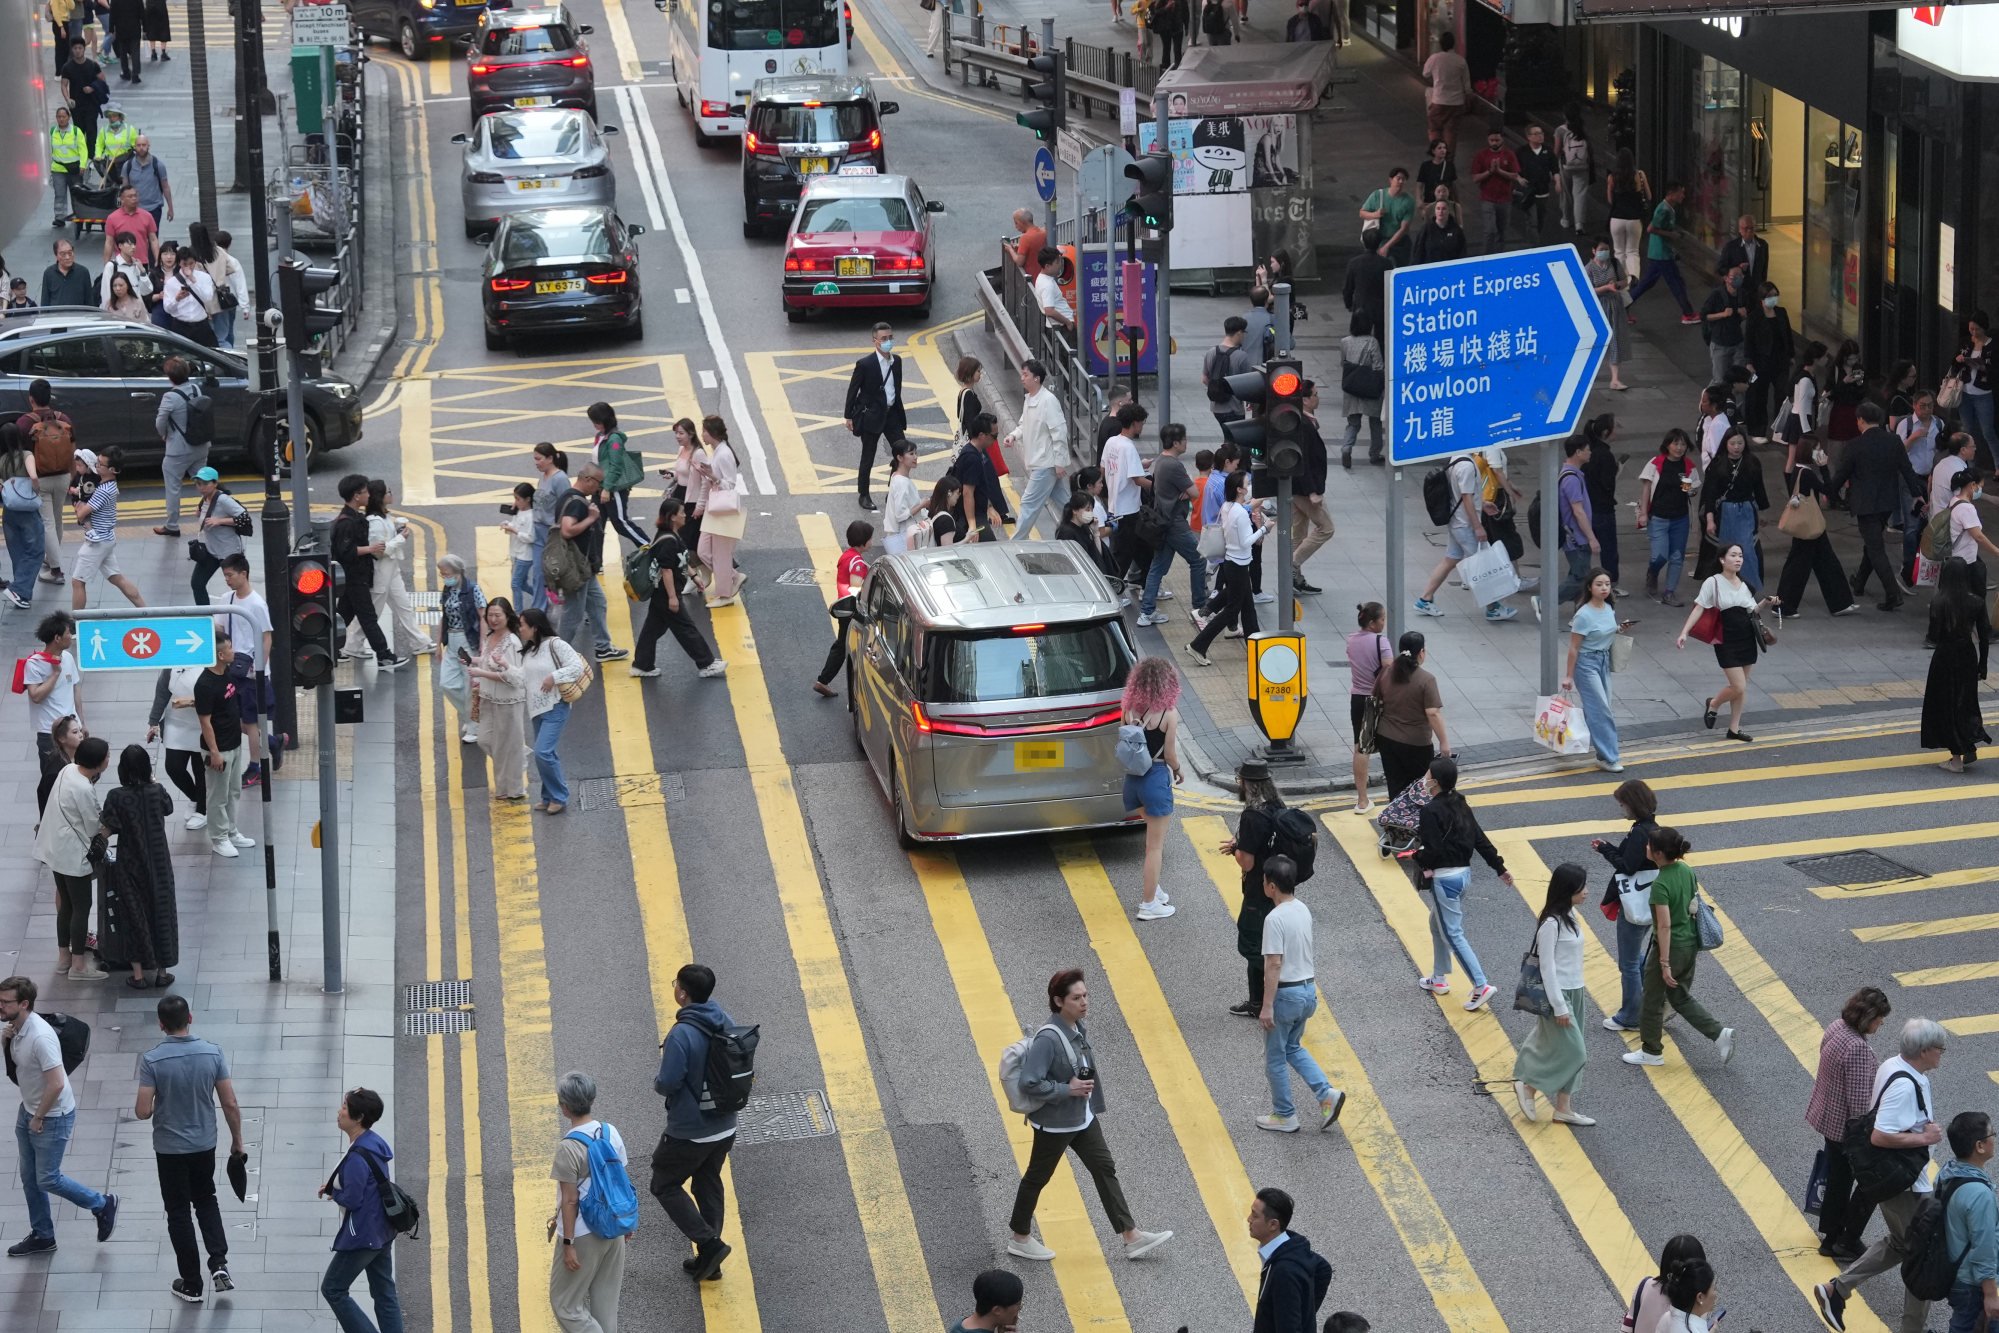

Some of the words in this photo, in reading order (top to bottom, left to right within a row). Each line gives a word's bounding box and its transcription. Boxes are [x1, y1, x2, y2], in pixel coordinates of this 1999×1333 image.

[321, 7, 333, 16] 10
[1246, 116, 1296, 130] VOGE
[842, 167, 874, 175] TAXI
[539, 283, 551, 292] XY
[555, 280, 581, 290] 6375
[1402, 278, 1466, 306] Airport
[1473, 272, 1541, 297] Express
[1402, 308, 1478, 336] Station
[1401, 375, 1491, 405] Kowloon
[1404, 406, 1455, 443] 九龍
